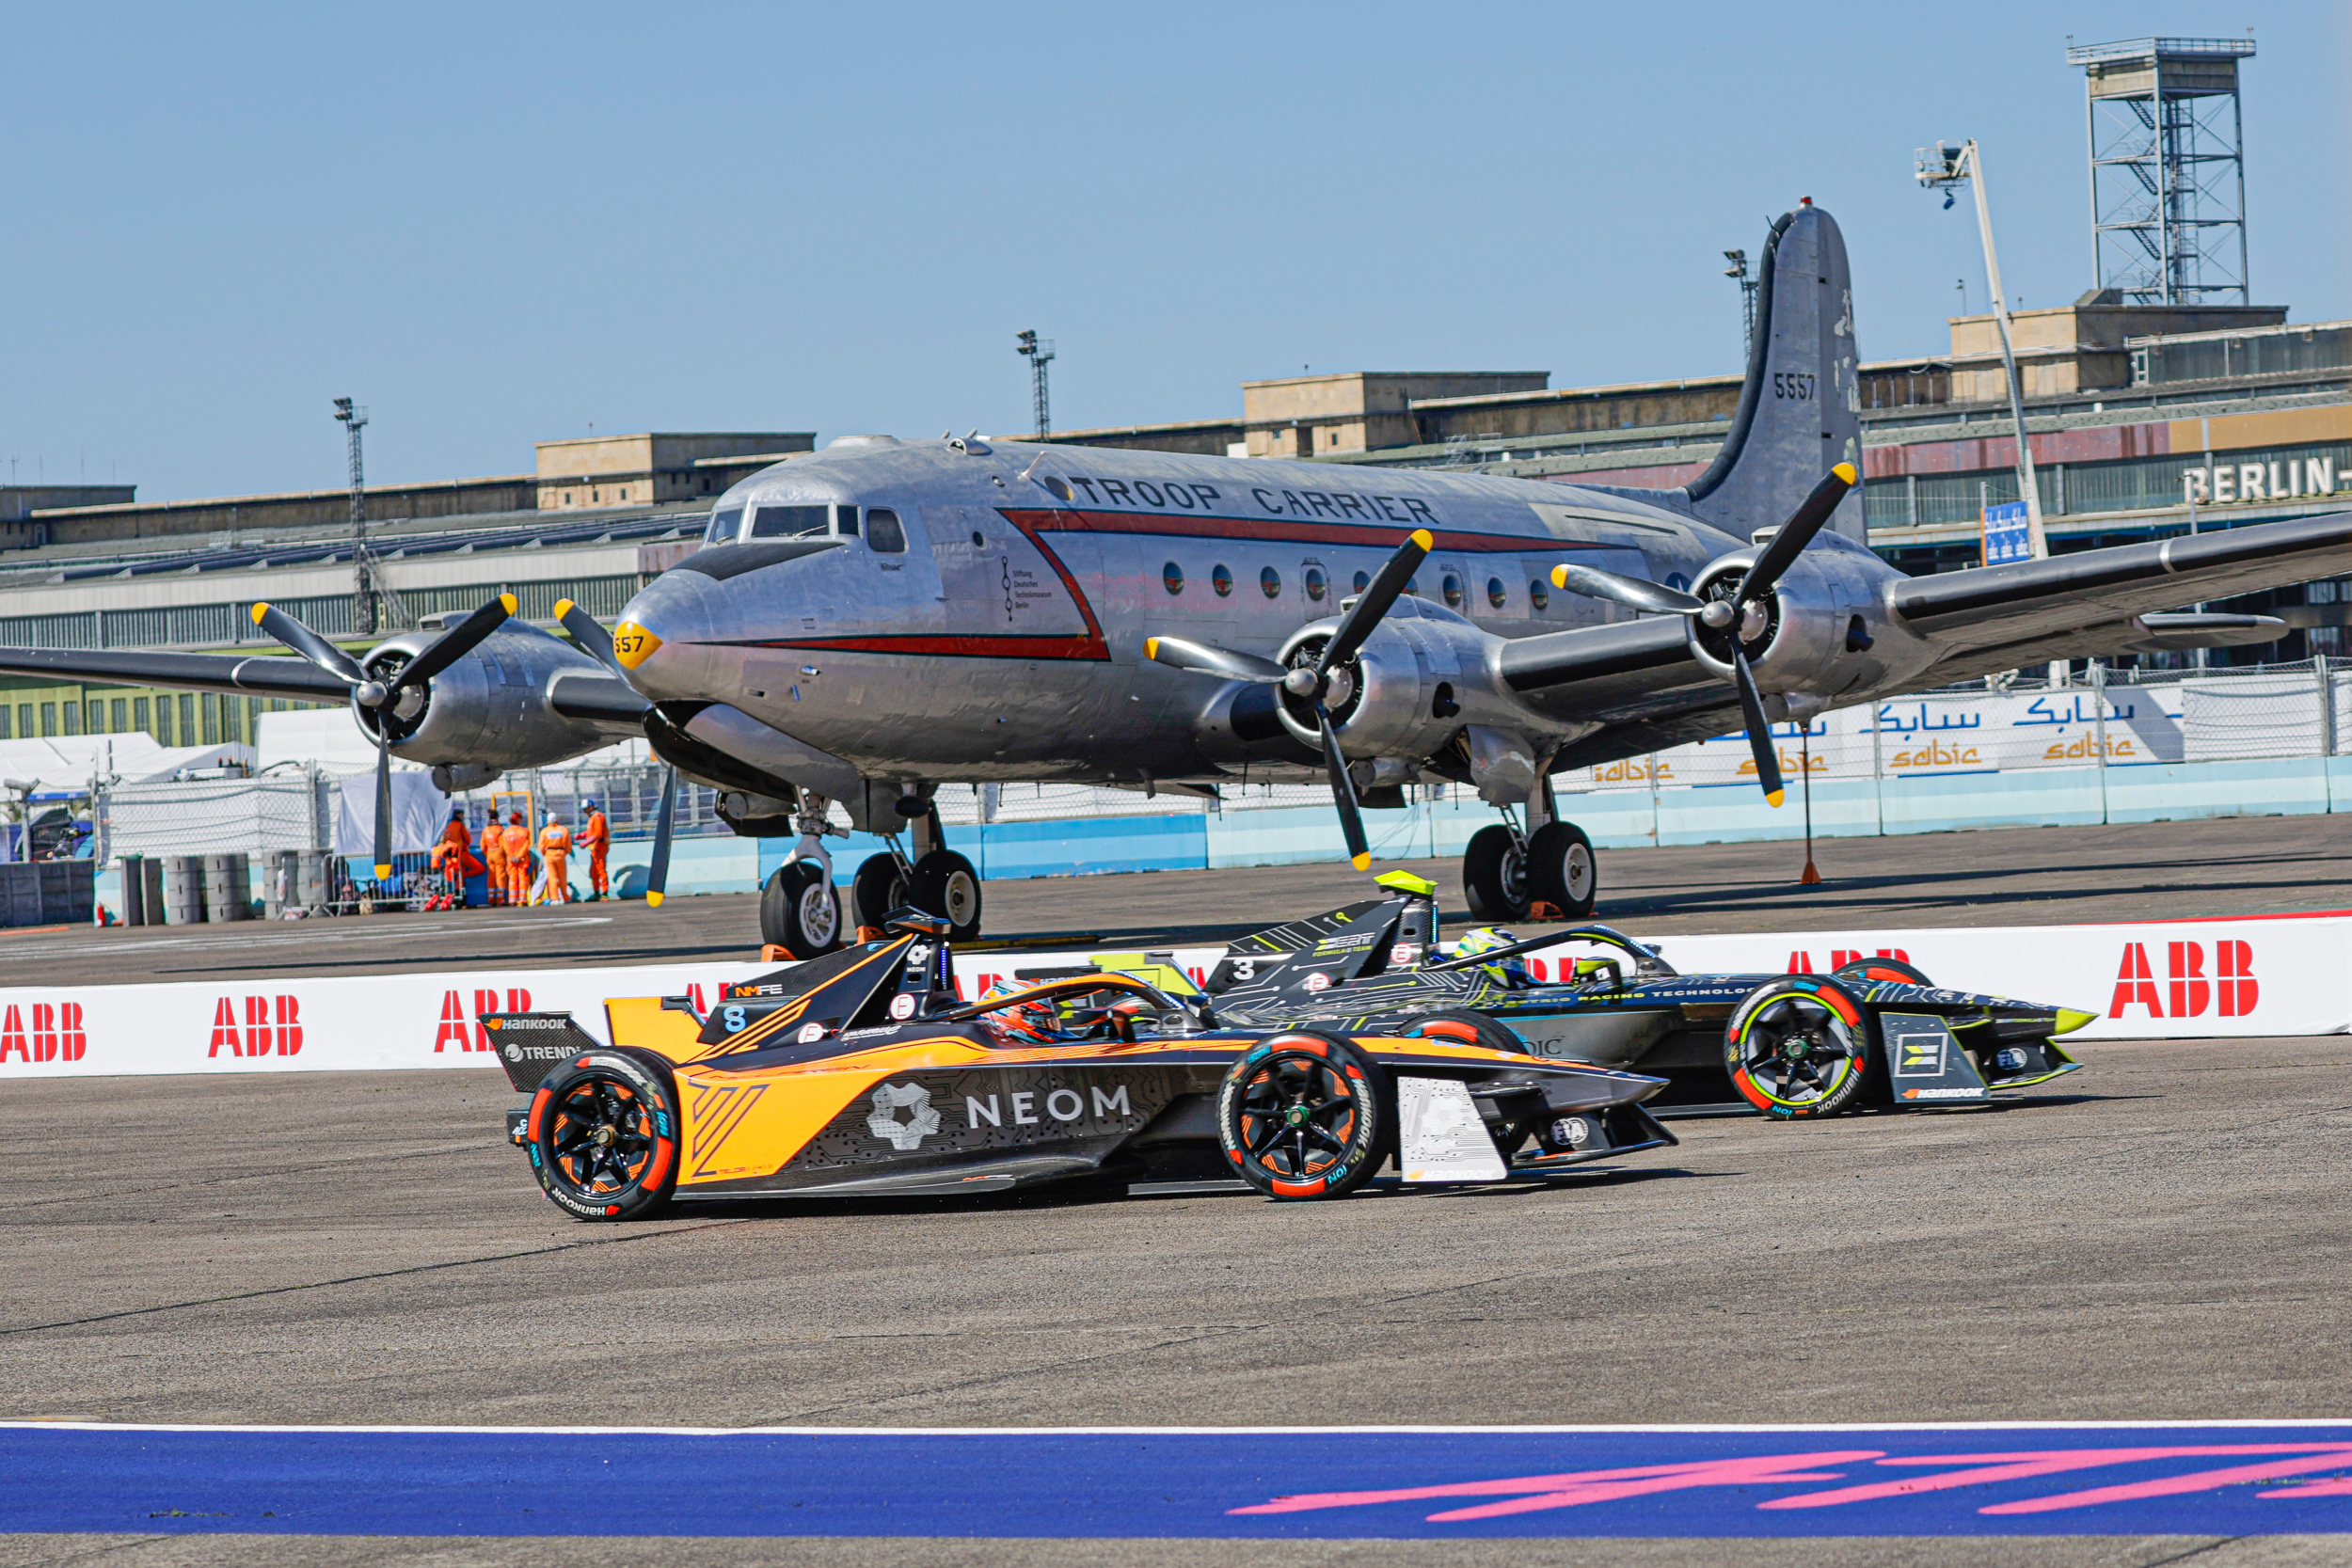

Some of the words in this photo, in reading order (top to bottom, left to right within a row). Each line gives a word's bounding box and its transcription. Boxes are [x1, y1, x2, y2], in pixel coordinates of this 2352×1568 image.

[1774, 372, 1815, 400] 5557
[1067, 476, 1221, 510] TROOP
[1251, 487, 1440, 524] CARRIER
[1012, 570, 1033, 579] Stiftung
[1859, 702, 1981, 741] سابك
[1890, 738, 1982, 768] sabic
[2042, 731, 2136, 760] sabic
[1233, 958, 1255, 980] 3
[2108, 940, 2259, 1019] ABB
[735, 984, 783, 997] NMFE
[0, 1002, 87, 1063] ABB
[208, 994, 304, 1057] ABB
[723, 1006, 747, 1033] 8
[966, 1085, 1131, 1129] NEOM
[1772, 1104, 1793, 1117] ION
[1327, 1164, 1348, 1184] ION
